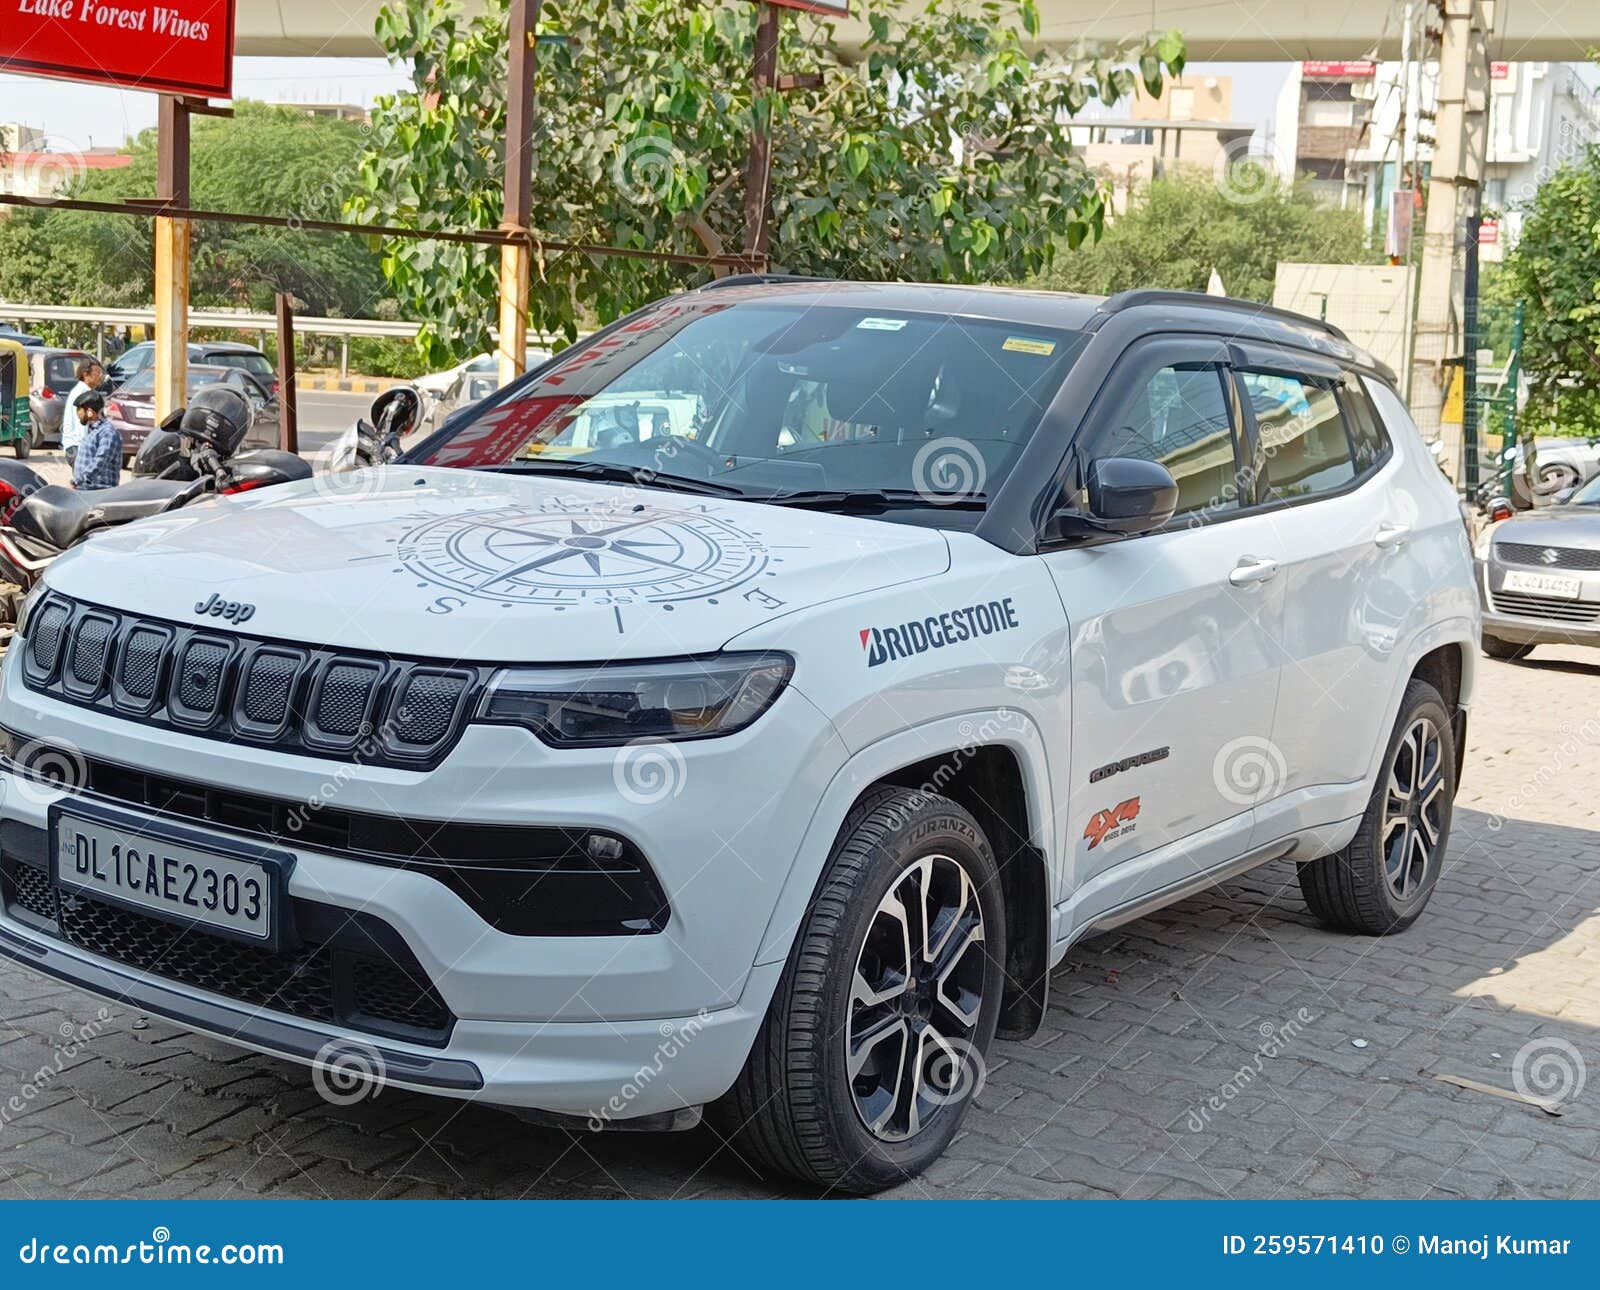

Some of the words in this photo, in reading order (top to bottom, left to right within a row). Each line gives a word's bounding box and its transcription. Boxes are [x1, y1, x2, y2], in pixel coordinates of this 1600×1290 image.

[79, 0, 146, 31] Forest
[151, 6, 210, 41] Wines
[194, 592, 257, 626] Jeep
[859, 597, 1020, 668] BRIDGESTONE
[906, 818, 976, 846] TURANZA
[75, 831, 261, 921] DL1CAE2303
